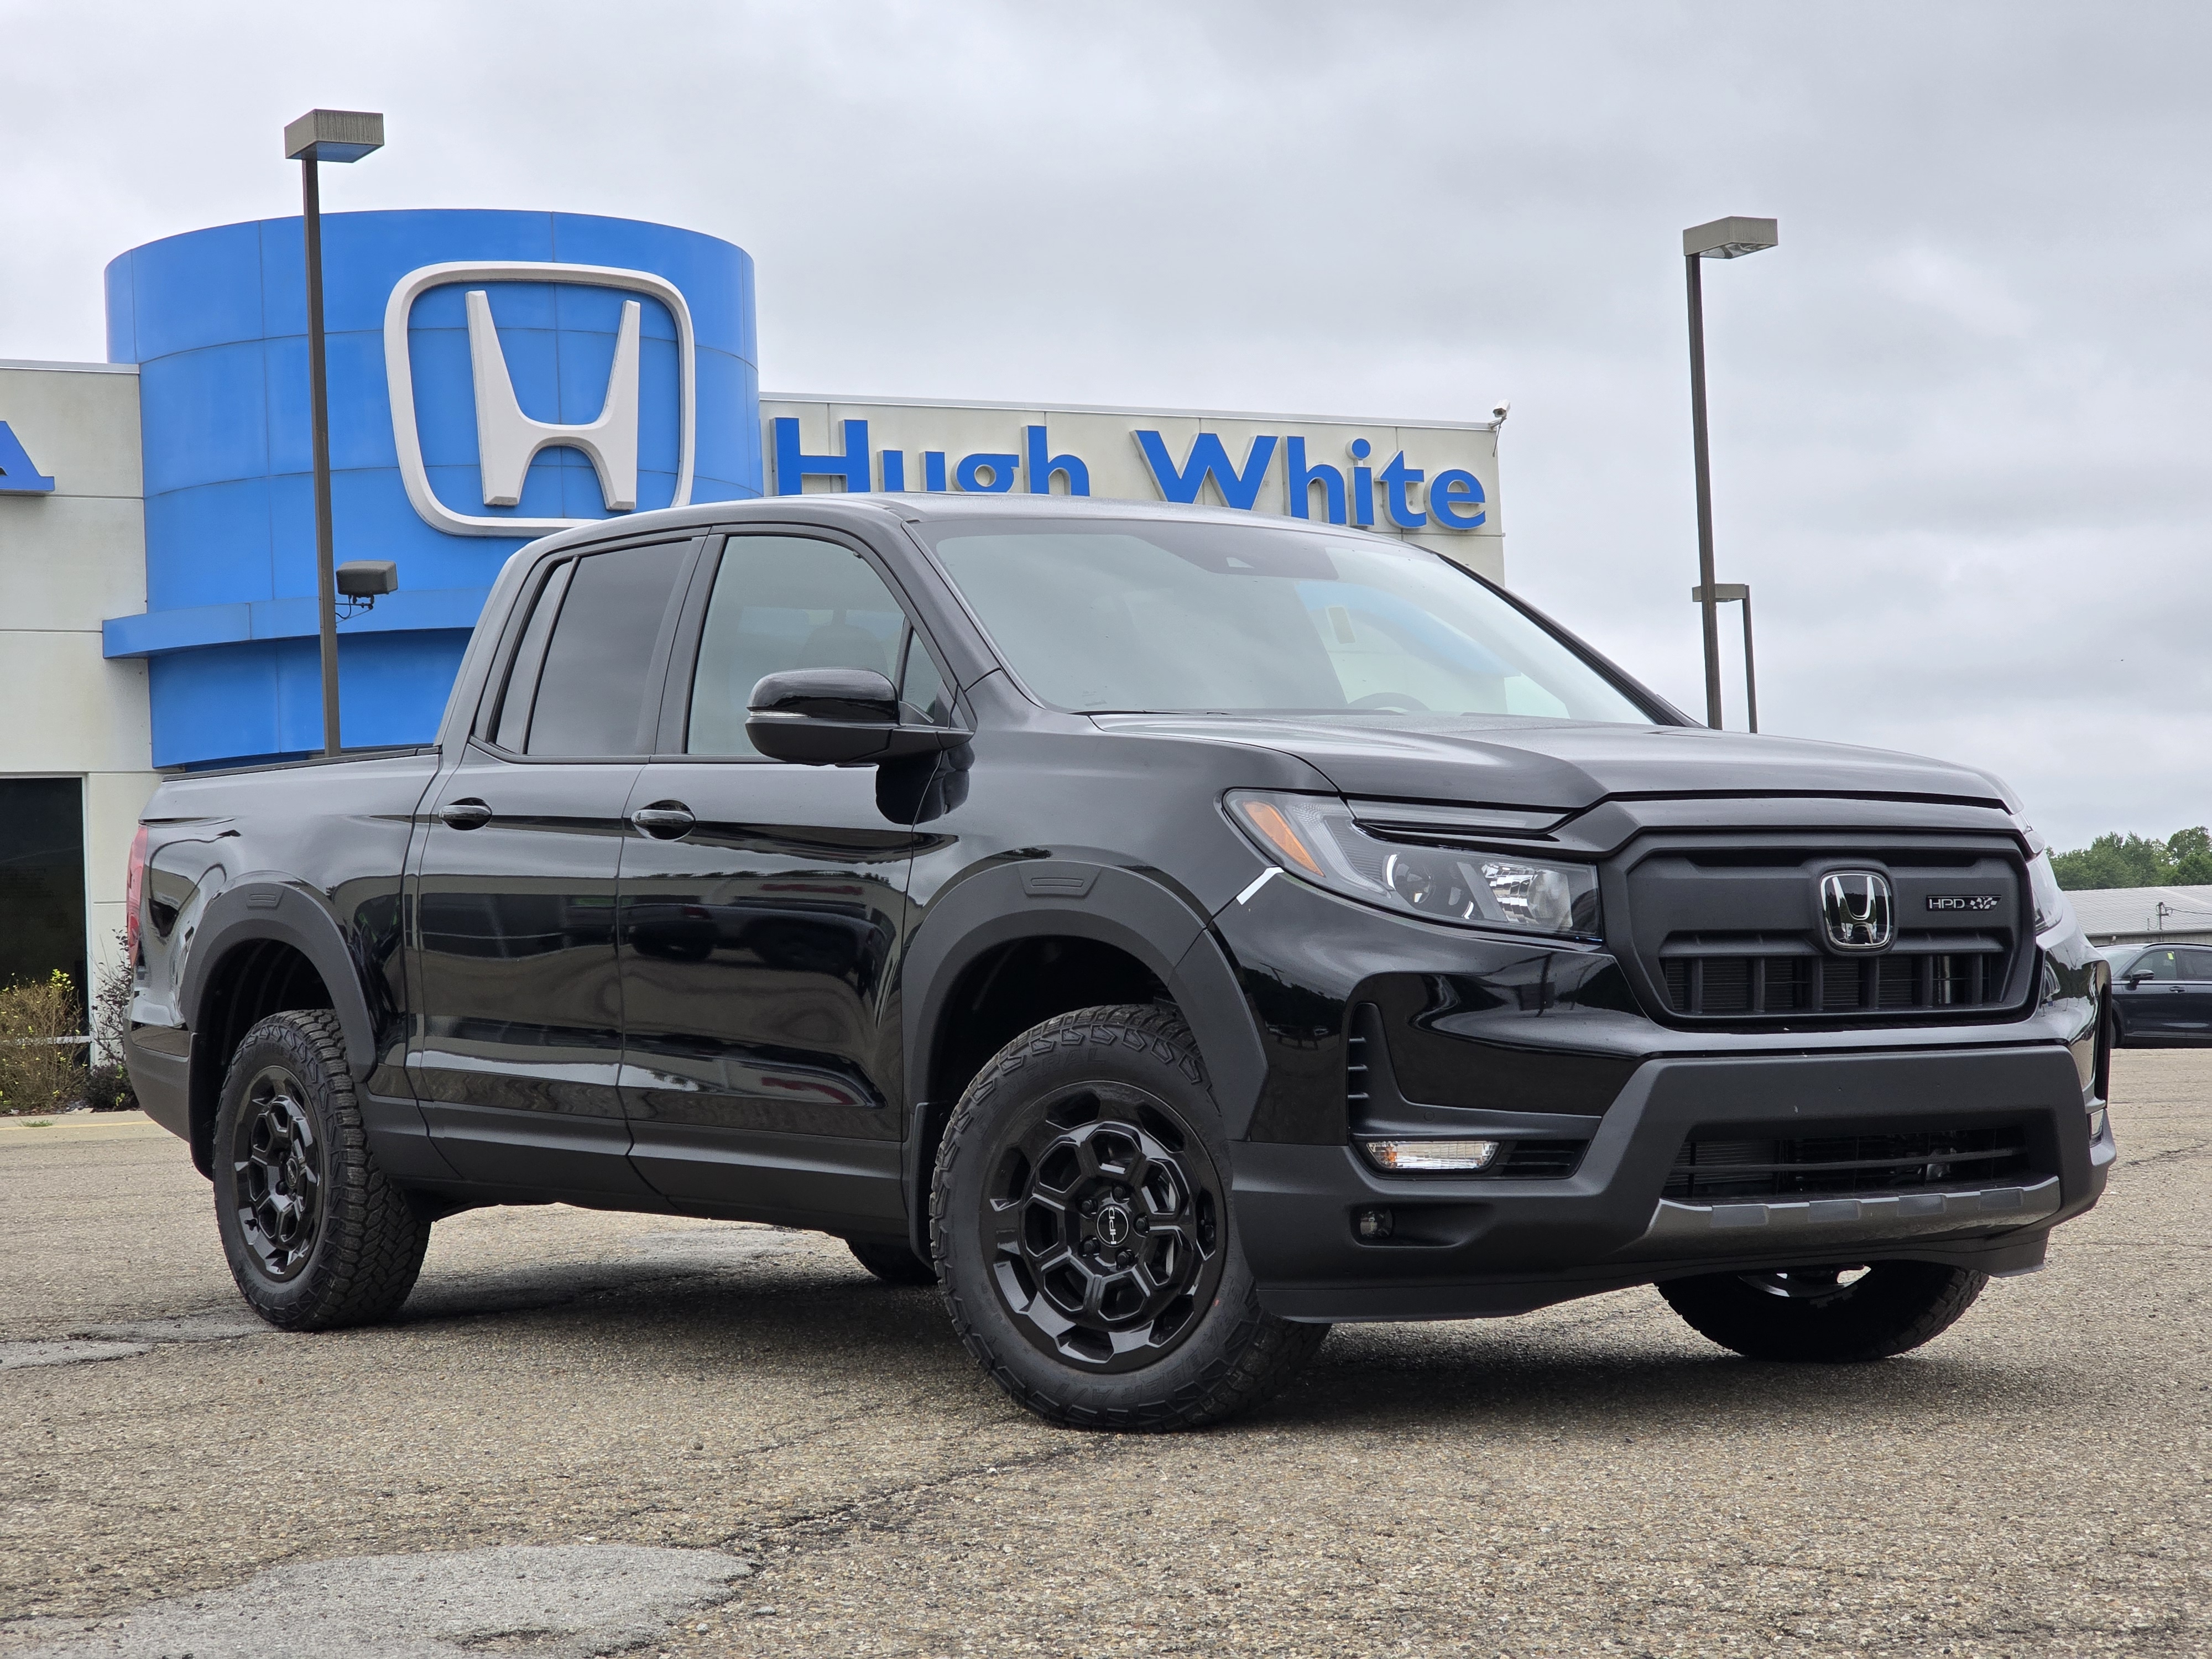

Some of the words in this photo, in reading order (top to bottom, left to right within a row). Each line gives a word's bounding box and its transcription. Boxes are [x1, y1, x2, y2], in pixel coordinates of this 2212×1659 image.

[771, 418, 1090, 497] Hugh
[1130, 430, 1486, 529] White
[1928, 898, 1965, 909] HPD
[1108, 1207, 1117, 1245] HPD
